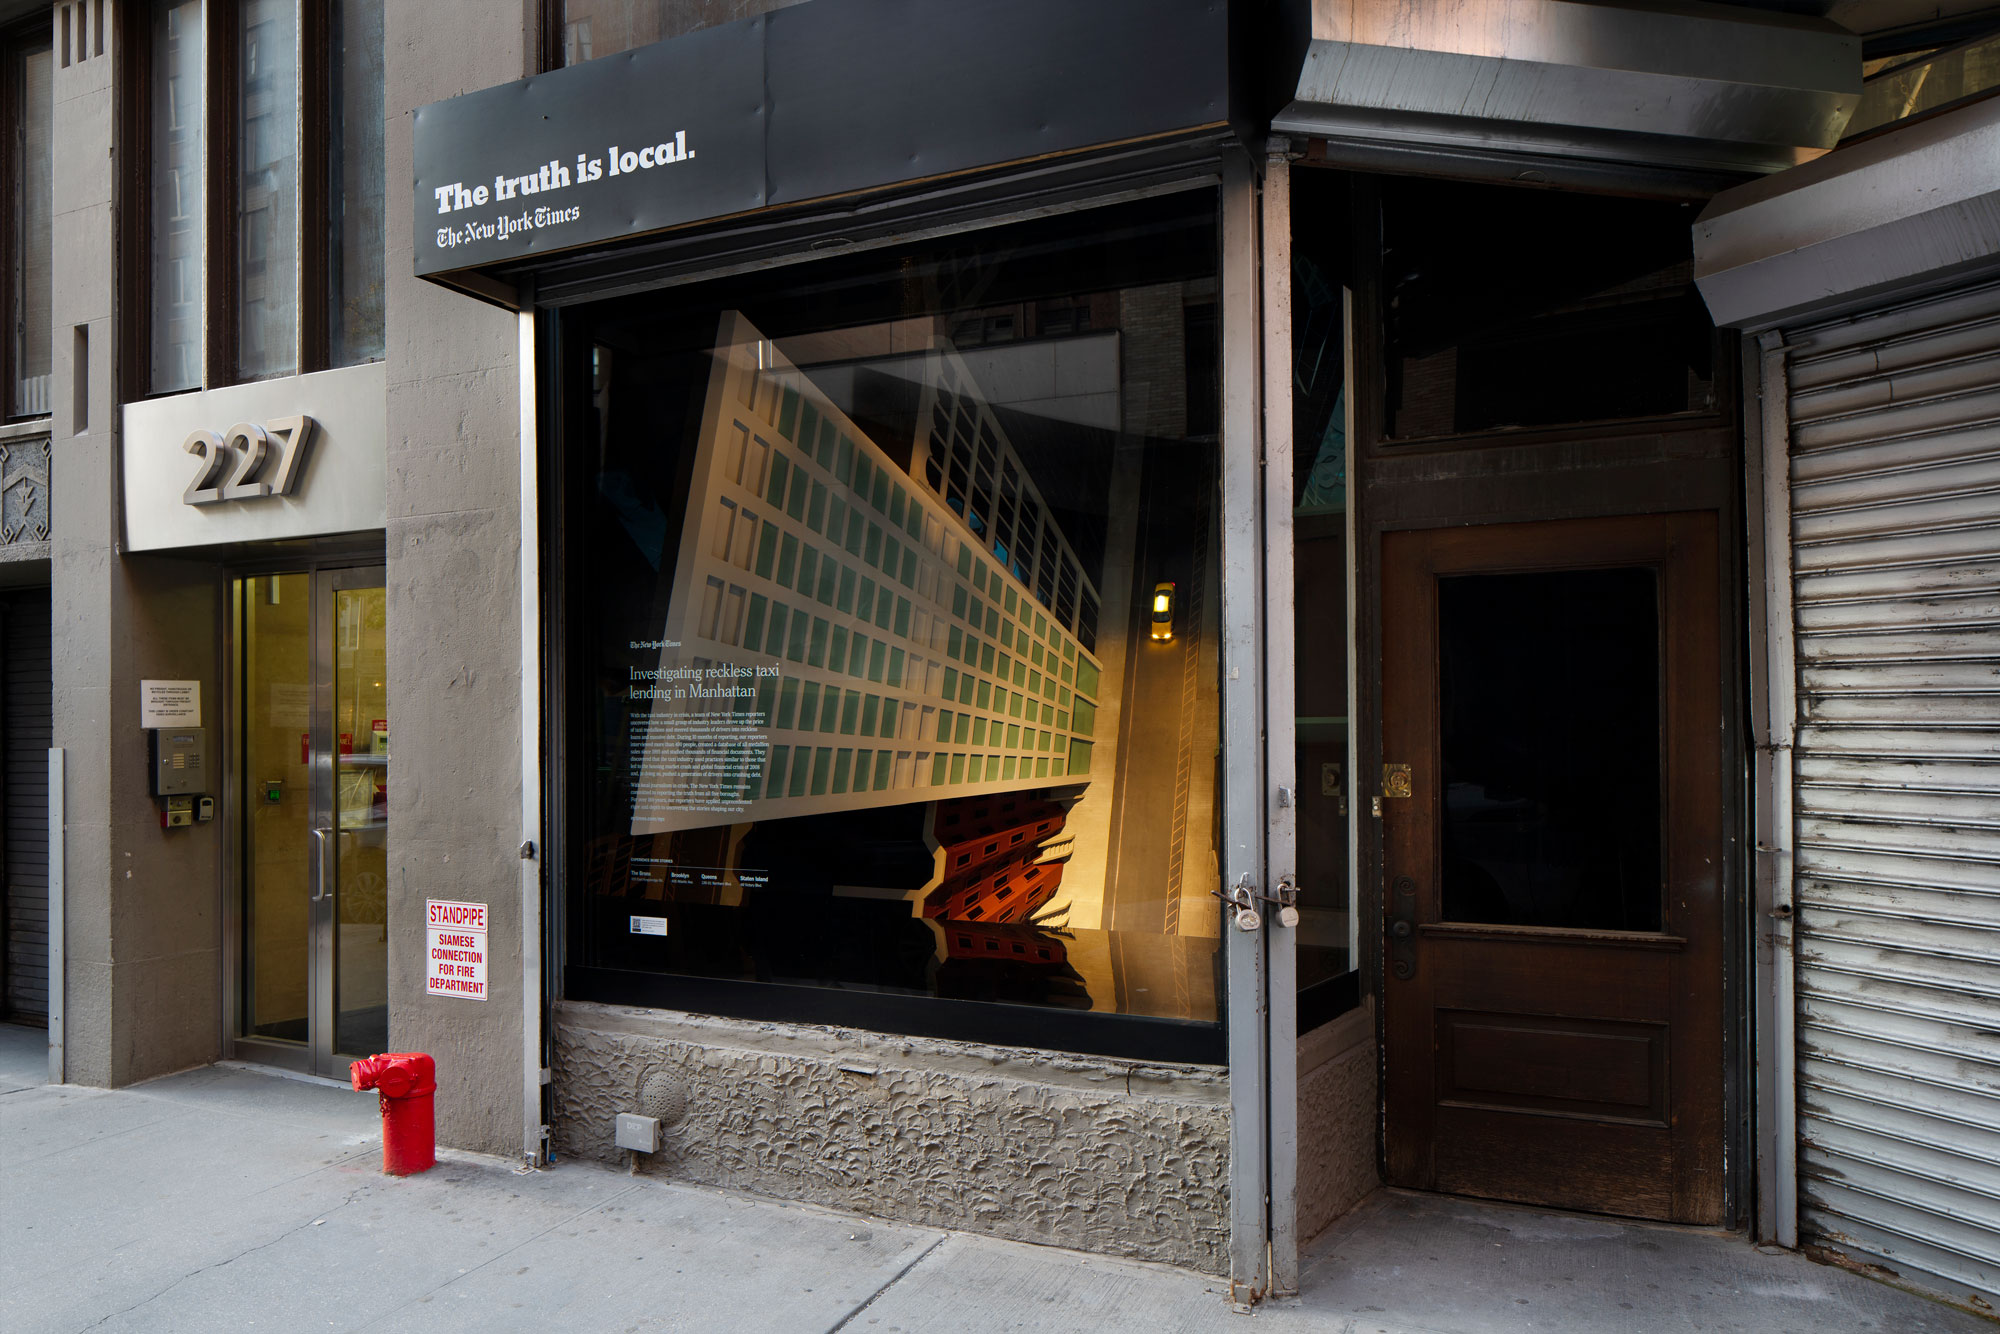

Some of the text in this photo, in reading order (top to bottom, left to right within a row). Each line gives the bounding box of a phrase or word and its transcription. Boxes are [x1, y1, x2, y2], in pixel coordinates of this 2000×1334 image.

[434, 130, 696, 214] The truth is local.
[436, 205, 580, 249] The New York Times
[183, 415, 312, 505] 227
[630, 639, 681, 650] The New York Times
[630, 662, 780, 682] Investigating reckless taxi
[630, 683, 756, 702] lending in Manhattan
[430, 904, 484, 927] STANDPIPE
[439, 933, 475, 948] SIAMESE
[431, 947, 483, 964] CONNECTION
[438, 963, 475, 978] FOR FIRE
[429, 977, 485, 994] DEPARTMENT
